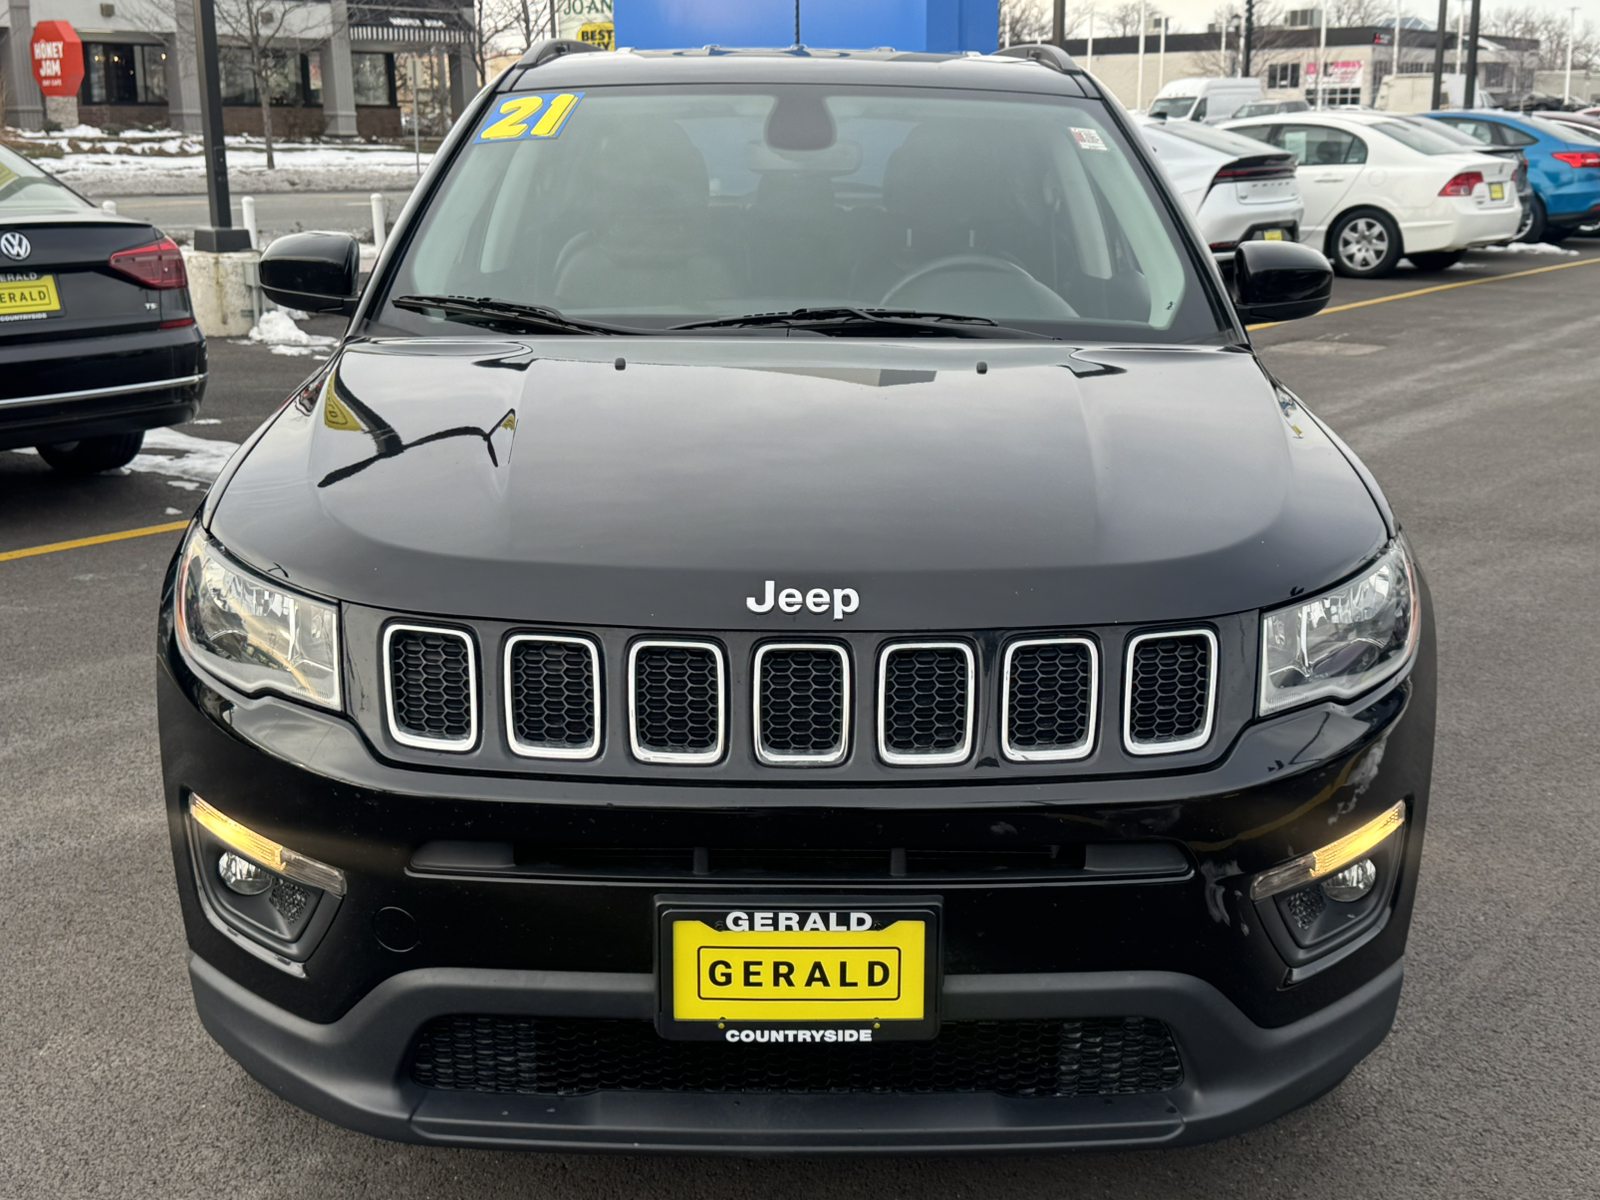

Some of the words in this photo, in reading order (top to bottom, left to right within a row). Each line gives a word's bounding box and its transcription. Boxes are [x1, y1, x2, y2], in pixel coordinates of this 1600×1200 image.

[582, 30, 613, 42] BEST
[34, 41, 63, 60] HONEY
[40, 60, 61, 76] JAM
[480, 93, 579, 140] 21
[746, 580, 860, 620] Jeep
[725, 911, 873, 932] GERALD
[708, 960, 891, 988] GERALD
[725, 1029, 873, 1043] COUNTRYSIDE
